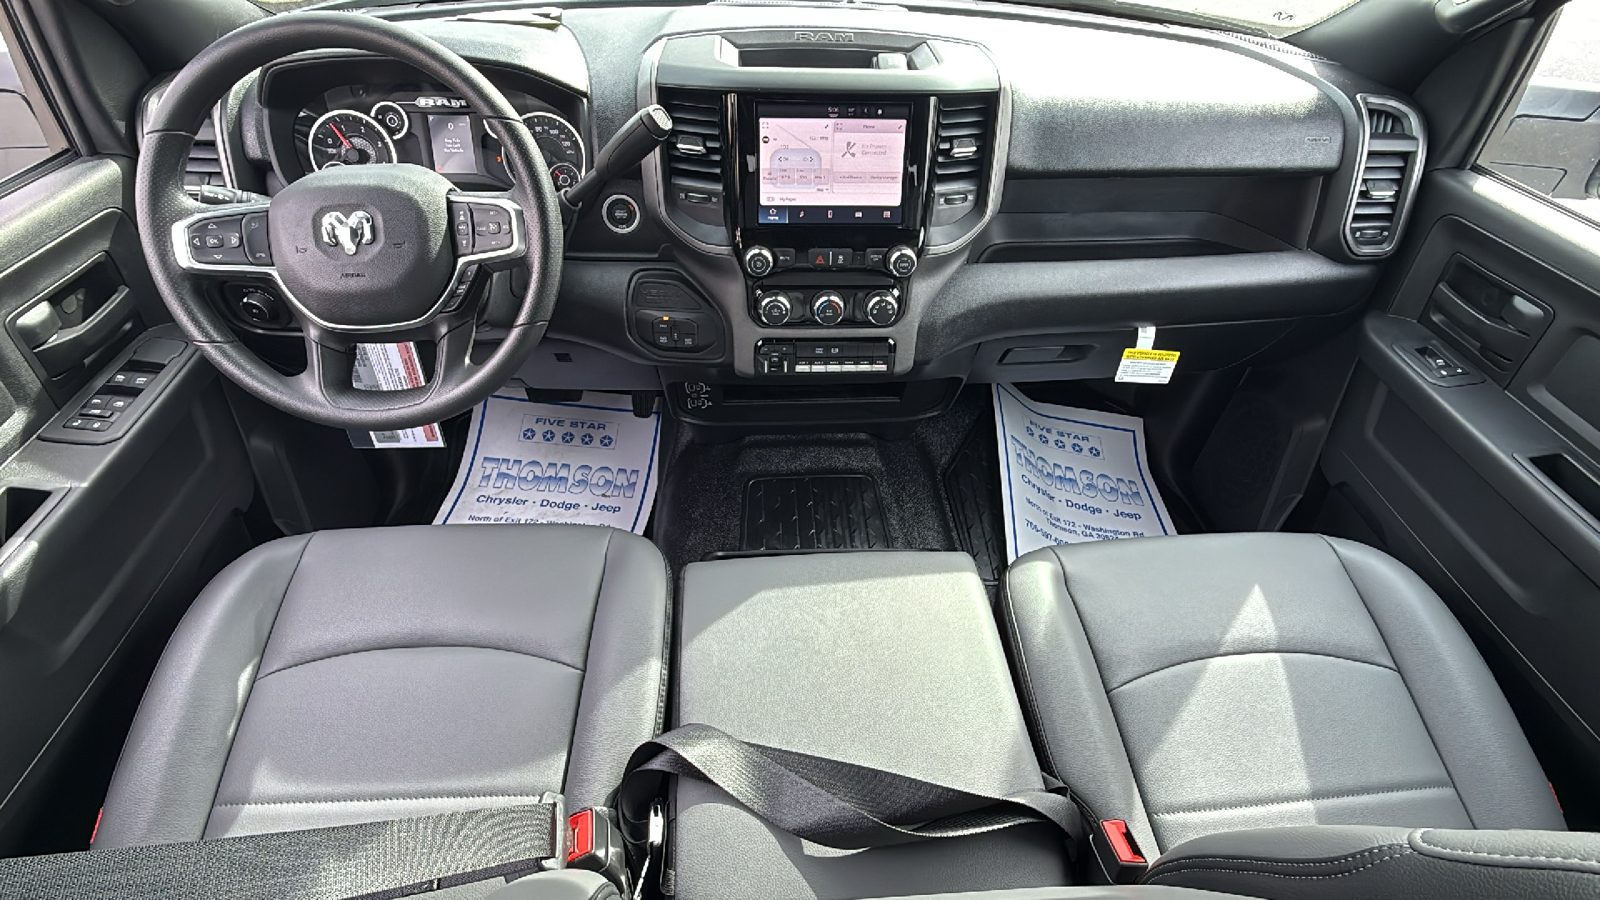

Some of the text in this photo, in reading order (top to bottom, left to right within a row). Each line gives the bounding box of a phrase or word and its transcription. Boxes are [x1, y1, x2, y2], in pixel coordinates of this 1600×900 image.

[794, 31, 854, 42] RAM
[419, 98, 467, 107] RAM
[535, 417, 607, 431] FIVE STAR
[1029, 420, 1090, 442] FIVE STAR
[478, 456, 640, 499] THOMSON
[1010, 434, 1145, 507] THOMSON
[476, 494, 622, 513] Chrysler Dodge Jeep
[1021, 474, 1142, 521] Chrysler Dodge Jeep
[467, 514, 492, 522] North
[504, 516, 521, 524] Exit
[1083, 523, 1131, 537] Washington
